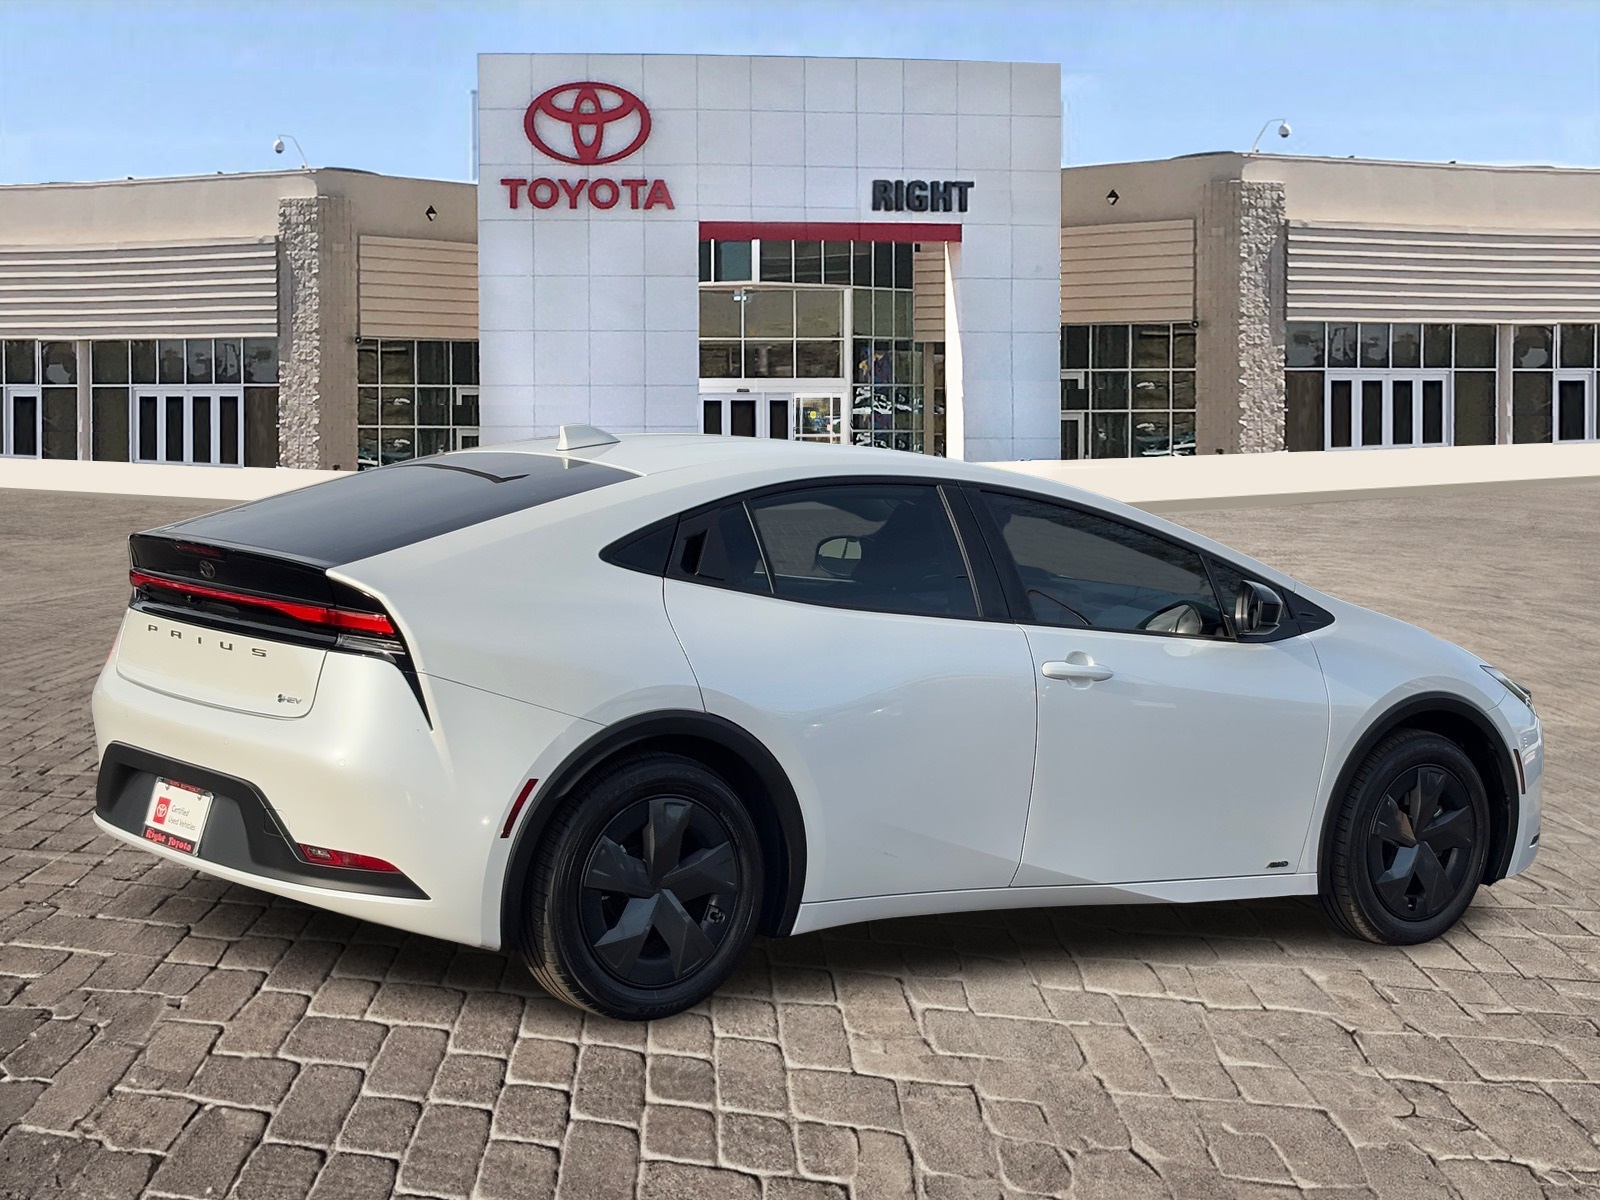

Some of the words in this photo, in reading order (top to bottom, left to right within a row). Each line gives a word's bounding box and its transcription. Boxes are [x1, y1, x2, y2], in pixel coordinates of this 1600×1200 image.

[500, 177, 675, 210] TOYOTA
[871, 179, 975, 212] RIGHT
[147, 624, 267, 658] PRIUS
[168, 815, 180, 826] Used
[171, 805, 190, 817] Certified
[145, 828, 166, 842] Right
[168, 837, 192, 851] Toyota
